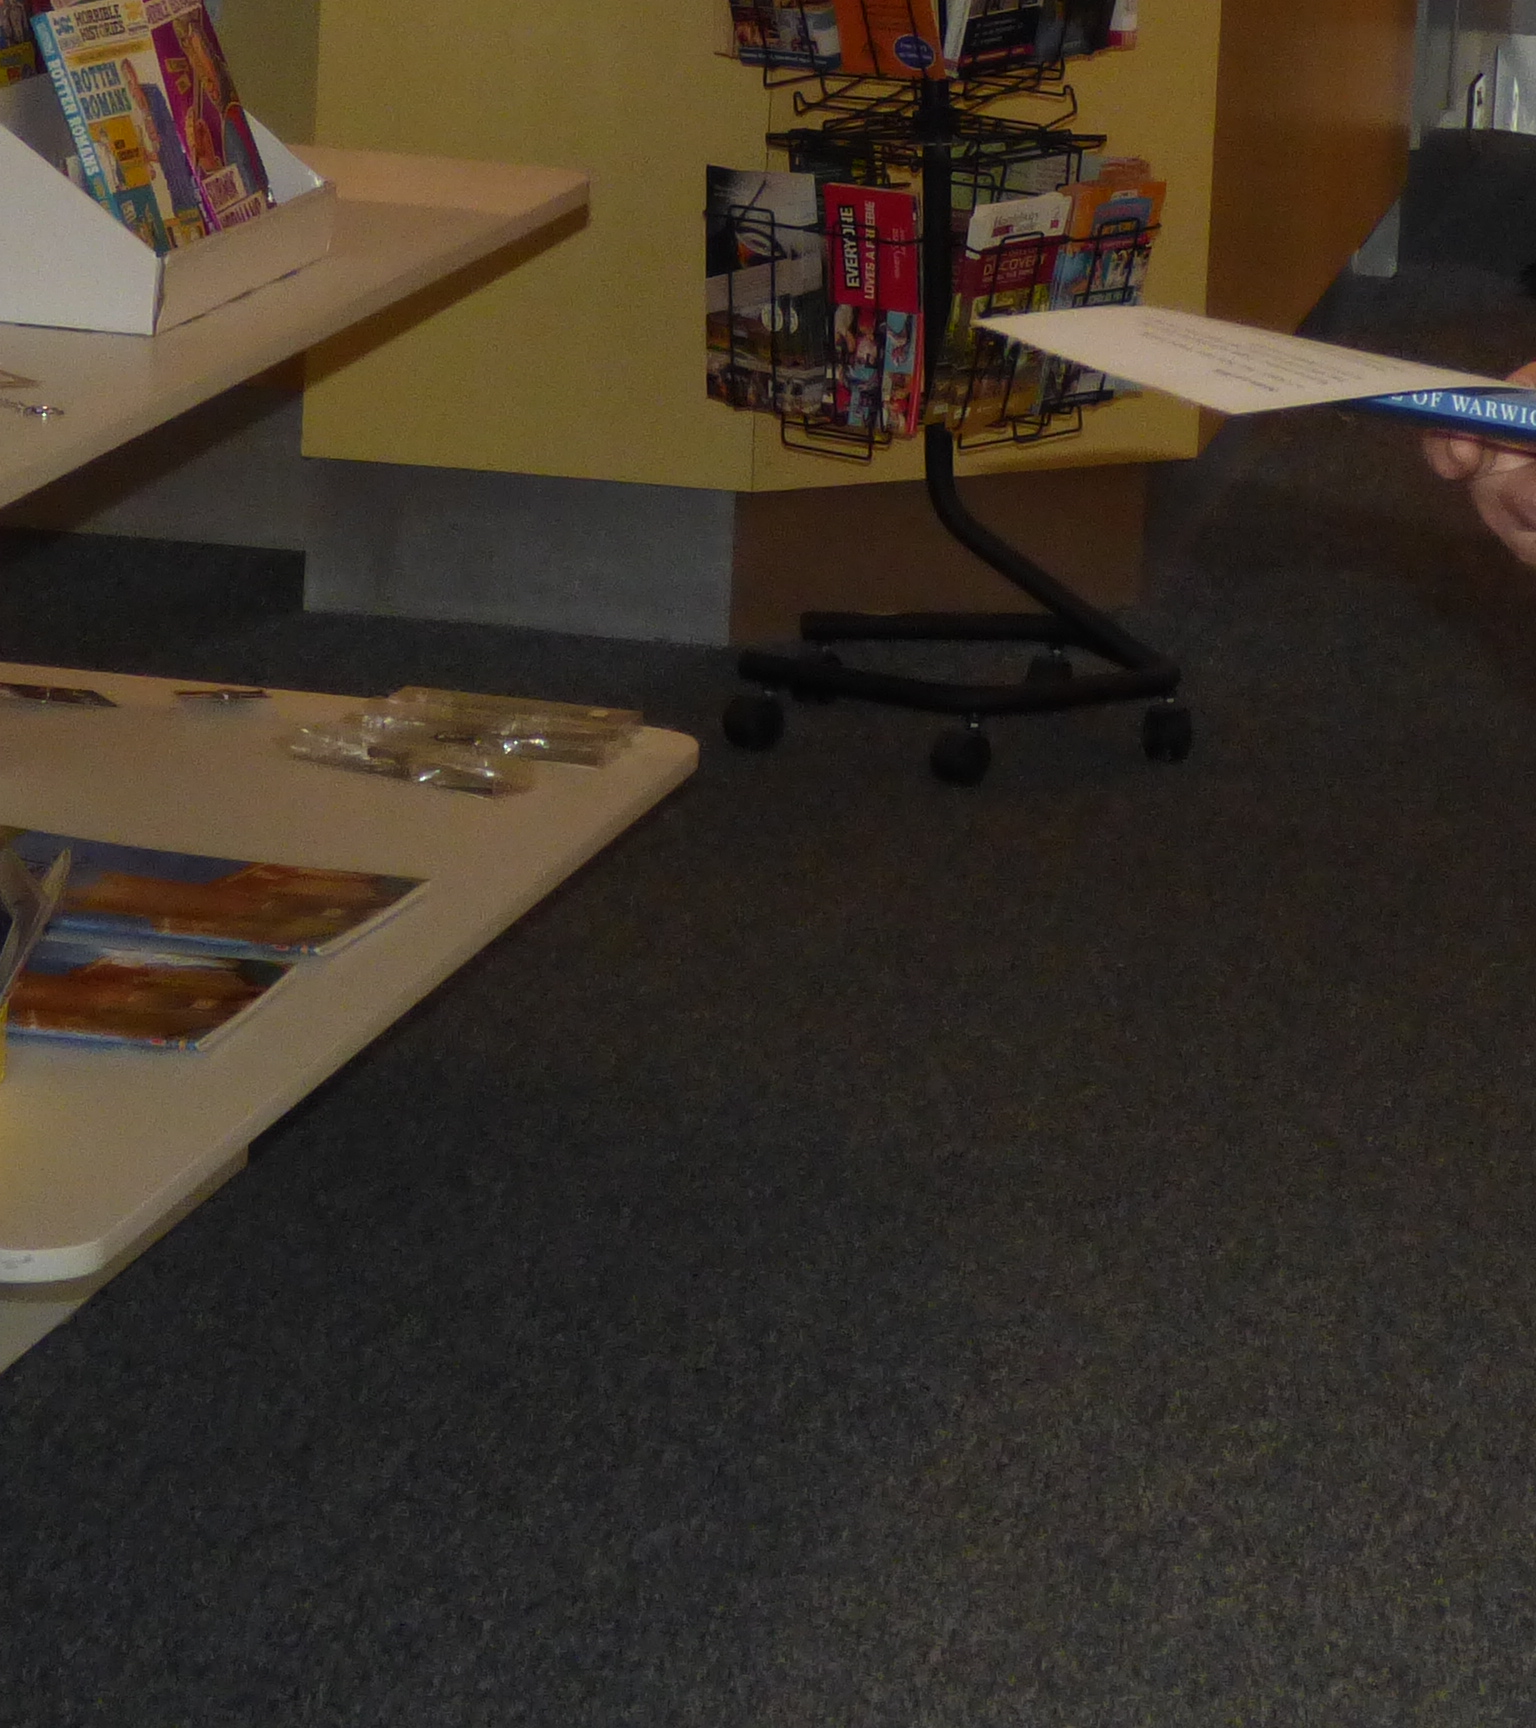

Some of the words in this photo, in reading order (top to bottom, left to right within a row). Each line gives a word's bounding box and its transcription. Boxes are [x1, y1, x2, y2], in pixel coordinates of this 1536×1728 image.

[73, 3, 121, 29] HORRIBLE
[79, 19, 126, 43] HISTORIES
[71, 59, 122, 96] ROTTEN
[46, 58, 77, 114] ROTTEN
[66, 114, 101, 176] ROMANS
[79, 86, 133, 122] ROMANS
[839, 206, 861, 288] EVERYONE
[864, 262, 876, 300] LOVES
[1412, 391, 1443, 408] OF
